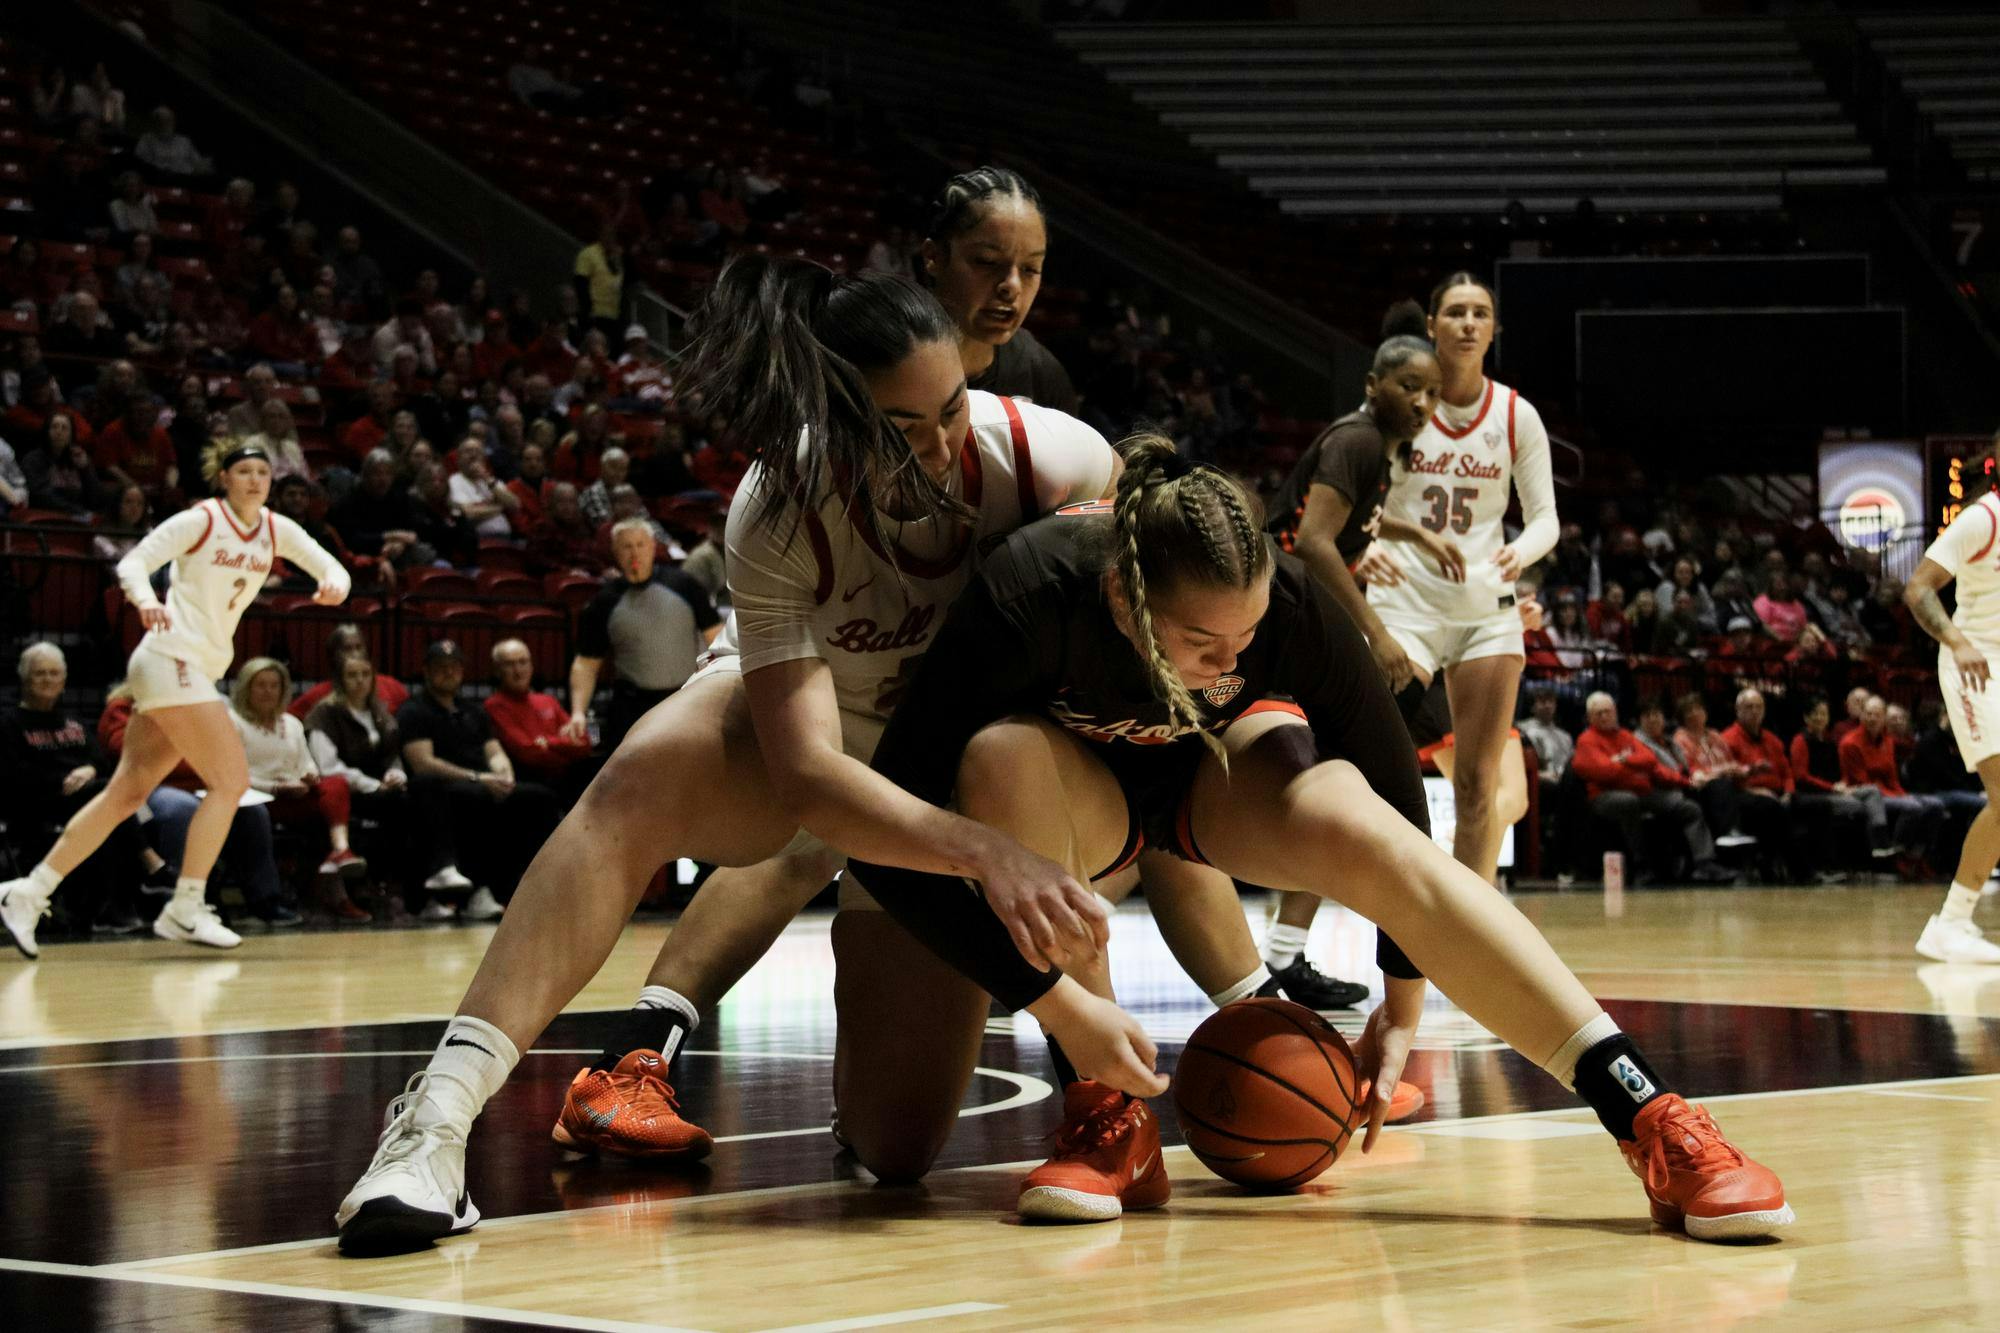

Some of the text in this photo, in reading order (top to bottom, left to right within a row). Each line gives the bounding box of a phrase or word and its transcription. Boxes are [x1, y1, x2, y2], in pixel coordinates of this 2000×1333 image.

[1951, 221, 1983, 267] 7
[1408, 450, 1502, 479] Ball State
[1421, 485, 1478, 535] 35
[211, 549, 246, 568] Ball
[228, 578, 247, 611] 2
[826, 604, 935, 654] Ball
[1206, 685, 1239, 697] MAC
